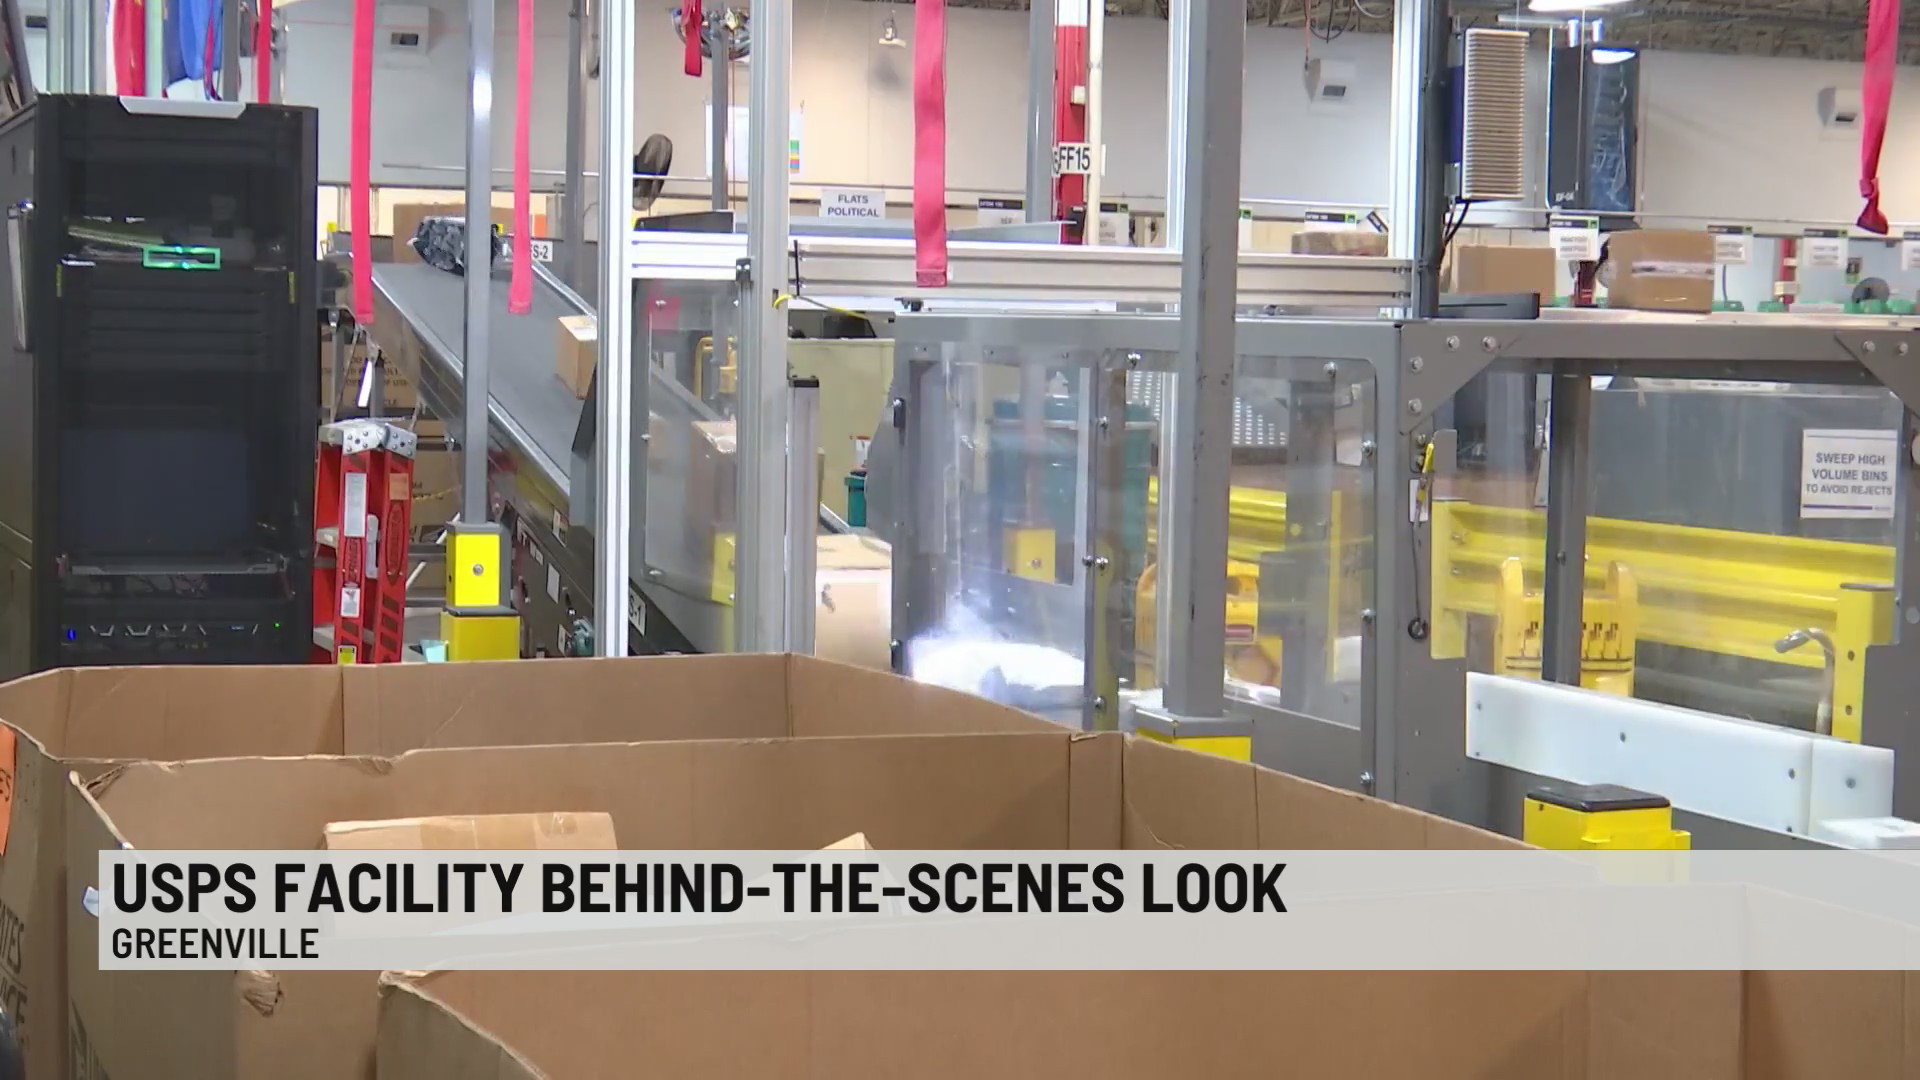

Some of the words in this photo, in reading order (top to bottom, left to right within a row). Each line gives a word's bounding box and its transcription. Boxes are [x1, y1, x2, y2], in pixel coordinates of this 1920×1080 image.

[1059, 146, 1090, 171] FF15
[838, 194, 869, 204] FLATS
[827, 206, 879, 217] POLITICAL
[530, 244, 549, 260] S-2
[1816, 452, 1855, 464] SWEEP
[1858, 454, 1885, 465] HIGH
[1812, 468, 1858, 480] VOLUME
[1861, 470, 1888, 482] BINS
[1806, 483, 1818, 494] TO
[1820, 484, 1849, 494] AVOID
[1851, 485, 1892, 496] REJECTS
